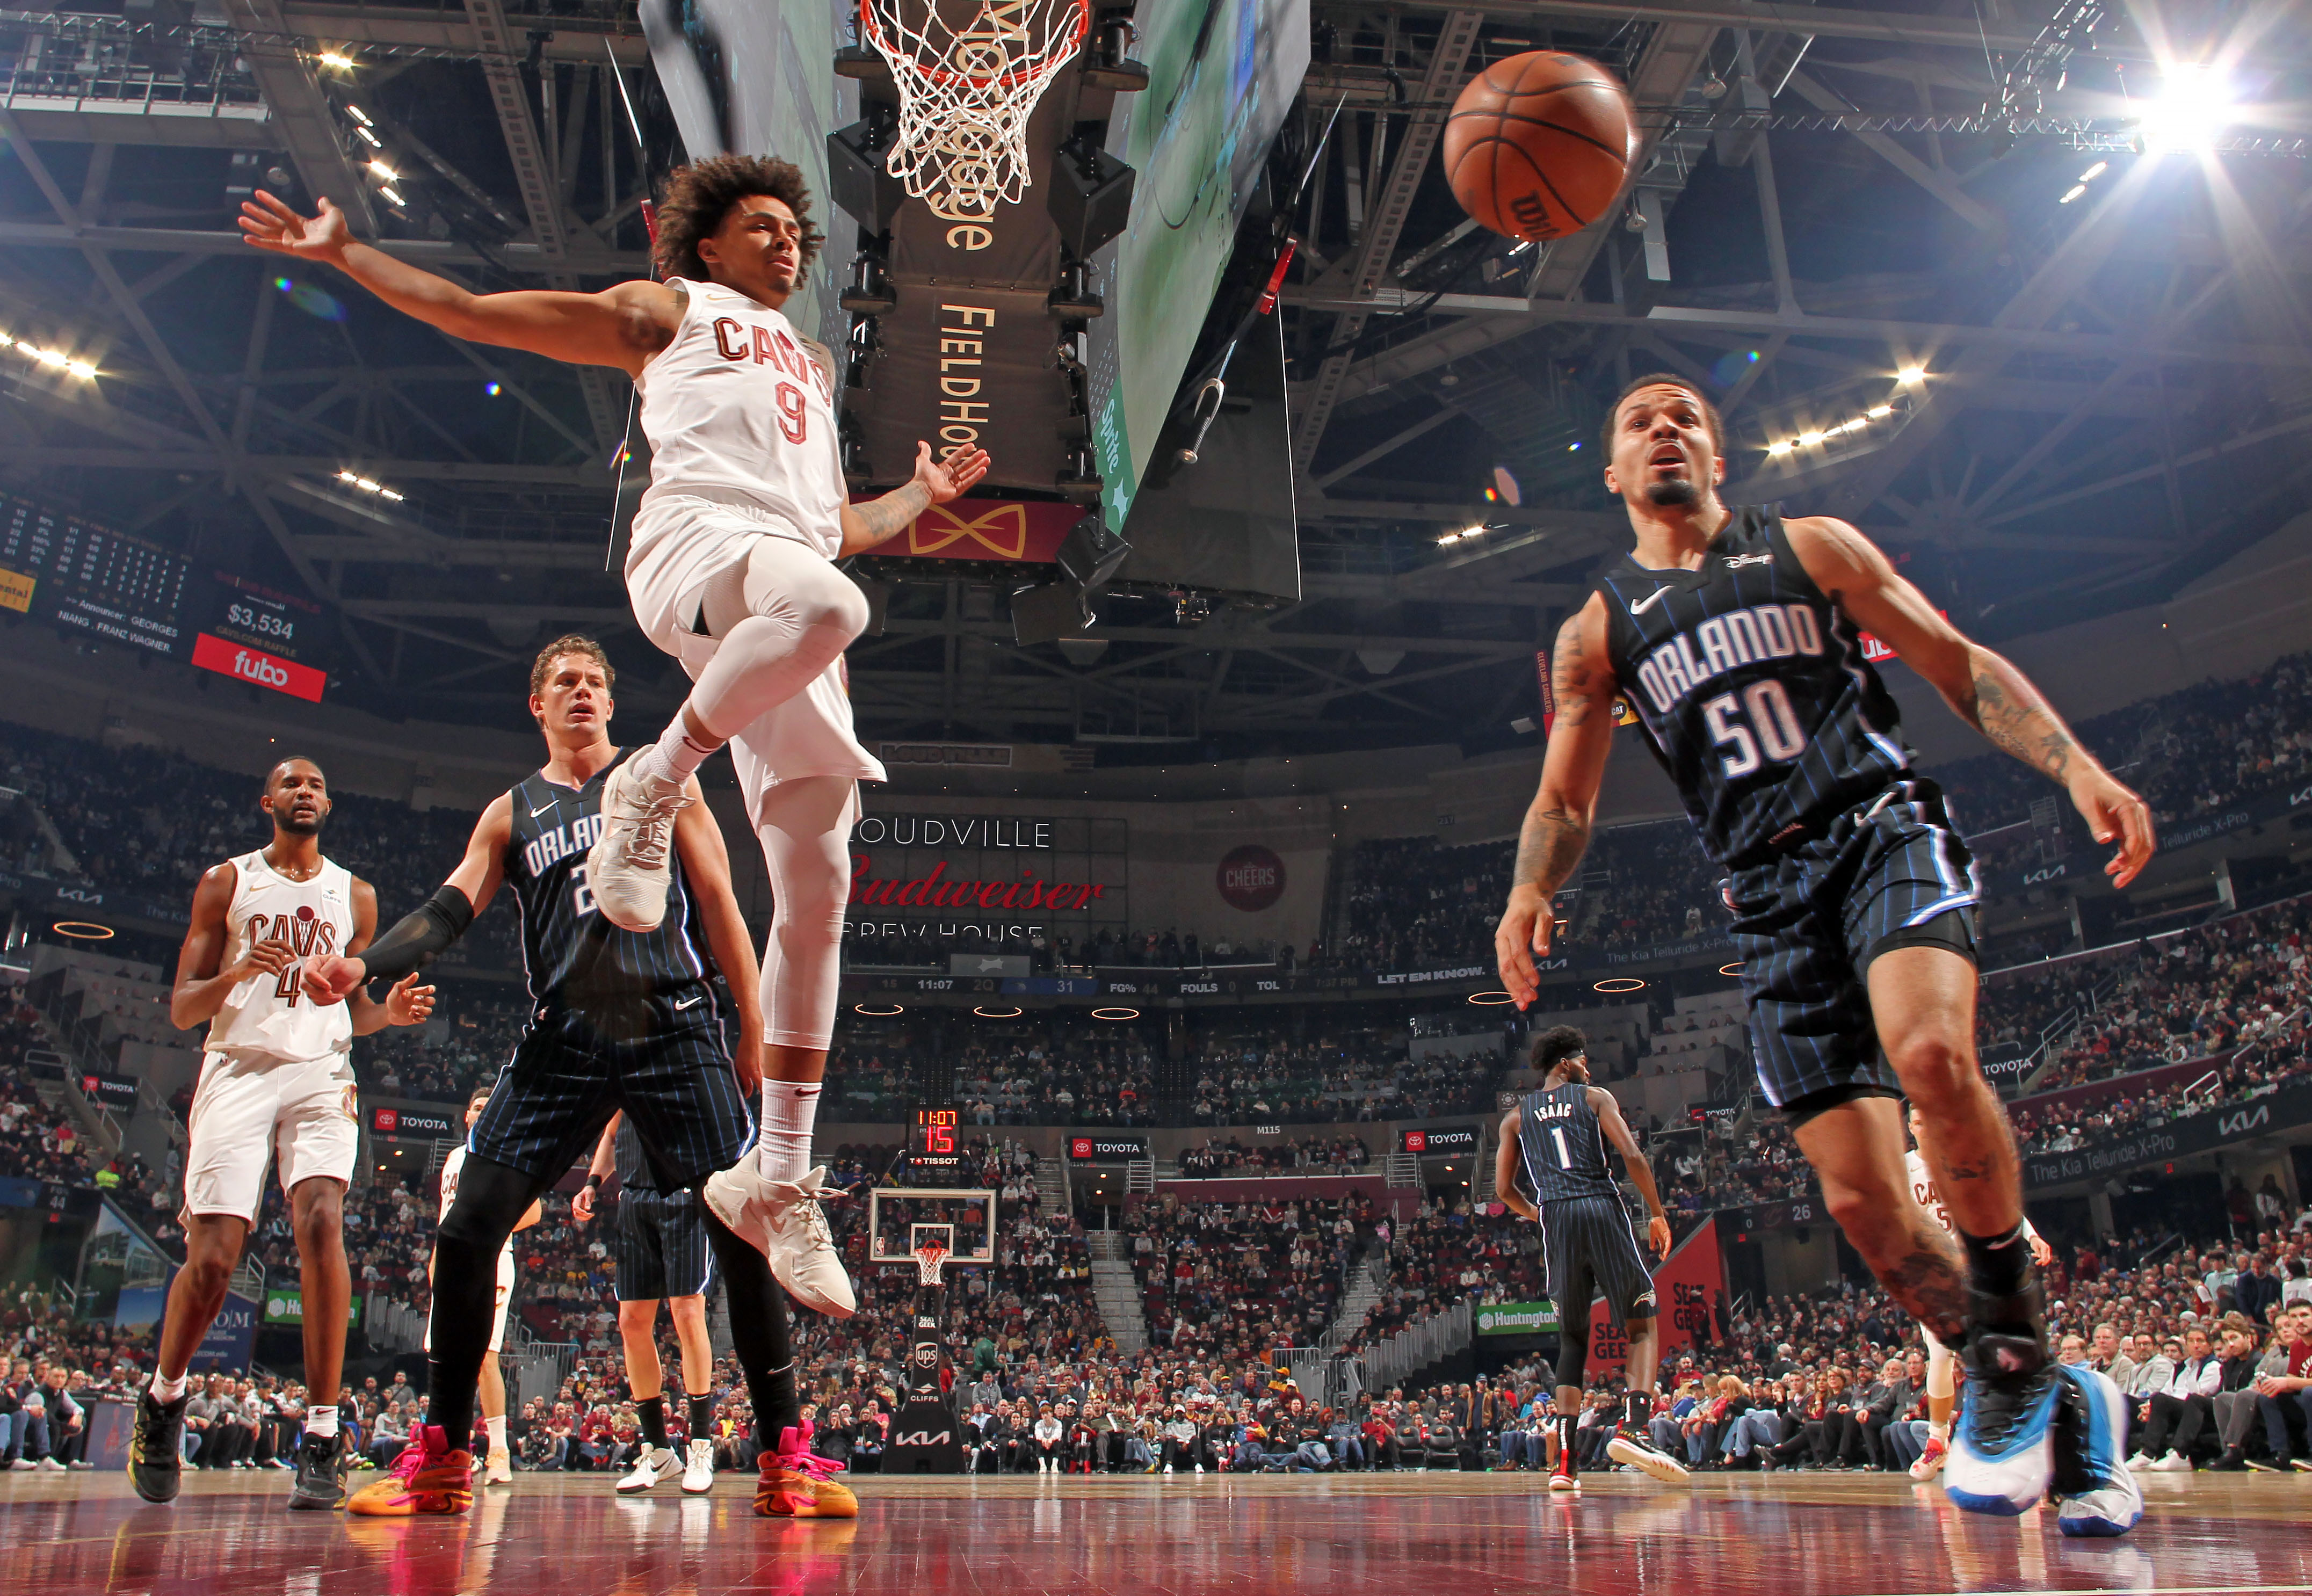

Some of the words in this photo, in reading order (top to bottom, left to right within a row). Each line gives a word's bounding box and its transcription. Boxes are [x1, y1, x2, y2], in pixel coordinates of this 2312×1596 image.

[713, 317, 832, 408] CAVS
[774, 381, 807, 445] 9
[1100, 398, 1120, 474] Sprite
[57, 610, 90, 627] NIANG
[96, 622, 128, 640] FRANZ
[131, 615, 178, 638] GEORGES
[228, 604, 293, 639] $3,534
[234, 650, 288, 687] fubo
[1537, 651, 1548, 683] CLEVELAND
[1637, 604, 1825, 714] ORLANDO
[1542, 684, 1552, 713] CAVALIERS
[1611, 705, 1623, 716] CAT
[1701, 678, 1808, 780] 50
[848, 818, 1050, 847] OUDVILLE
[2161, 824, 2213, 850] Telluride
[2214, 811, 2250, 832] X-Pro
[847, 854, 1104, 910] Budweiser
[1226, 868, 1275, 887] CHEERS
[2024, 864, 2066, 886] KIA
[56, 888, 103, 904] KIA
[322, 894, 342, 904] CLIFFS
[249, 913, 336, 957] CAVS
[1607, 952, 1628, 963] The
[1632, 949, 1649, 961] Kia
[1654, 942, 1698, 957] Telluride
[918, 980, 953, 990] 11:07
[974, 978, 995, 992] 2Q
[1378, 974, 1407, 984] LET
[1409, 972, 1431, 982] EM
[1433, 967, 1485, 980] KNOW.
[274, 966, 302, 1008] 4
[1057, 980, 1074, 993] 31
[1110, 983, 1136, 993] FG%
[1181, 983, 1218, 993] FOULS
[1257, 981, 1280, 991] TOL
[1982, 1058, 2034, 1076] TOYOTA
[102, 1080, 134, 1093] TOYOTA
[919, 1110, 957, 1126] 11:07
[1533, 1102, 1572, 1122] ISAAC
[2218, 1105, 2270, 1136] KIA
[401, 1116, 448, 1130] TOYOTA
[1257, 1126, 1280, 1135] M115
[926, 1126, 954, 1153] 15
[1095, 1143, 1140, 1153] TOYOTA
[1428, 1133, 1473, 1144] TOYOTA
[1549, 1126, 1571, 1170] 1
[2031, 1164, 2058, 1183] The
[2061, 1157, 2083, 1177] Kia
[2085, 1145, 2136, 1170] Telluride
[2137, 1134, 2176, 1157] X-Pro
[1792, 1203, 1811, 1221] 26
[917, 1350, 937, 1365] ups
[896, 1431, 950, 1447] KIA
